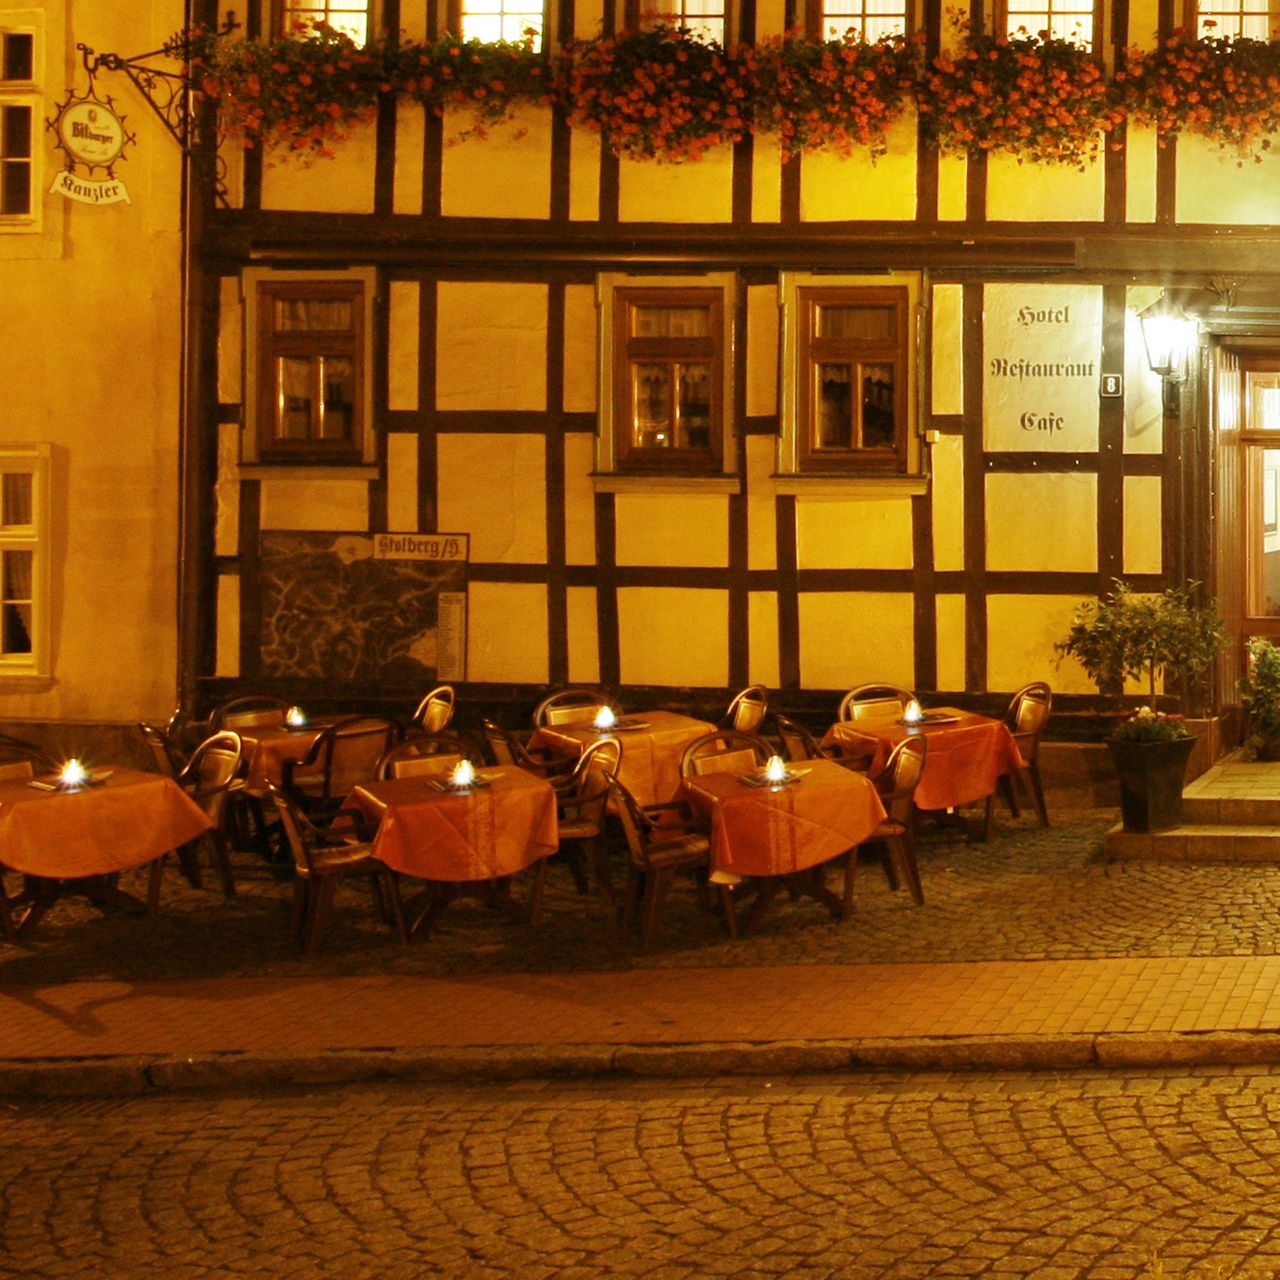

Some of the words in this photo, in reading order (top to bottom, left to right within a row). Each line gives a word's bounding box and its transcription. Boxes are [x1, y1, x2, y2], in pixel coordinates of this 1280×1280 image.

[61, 175, 119, 202] Kanzler
[1017, 305, 1070, 330] Hotel
[1106, 376, 1117, 394] 8
